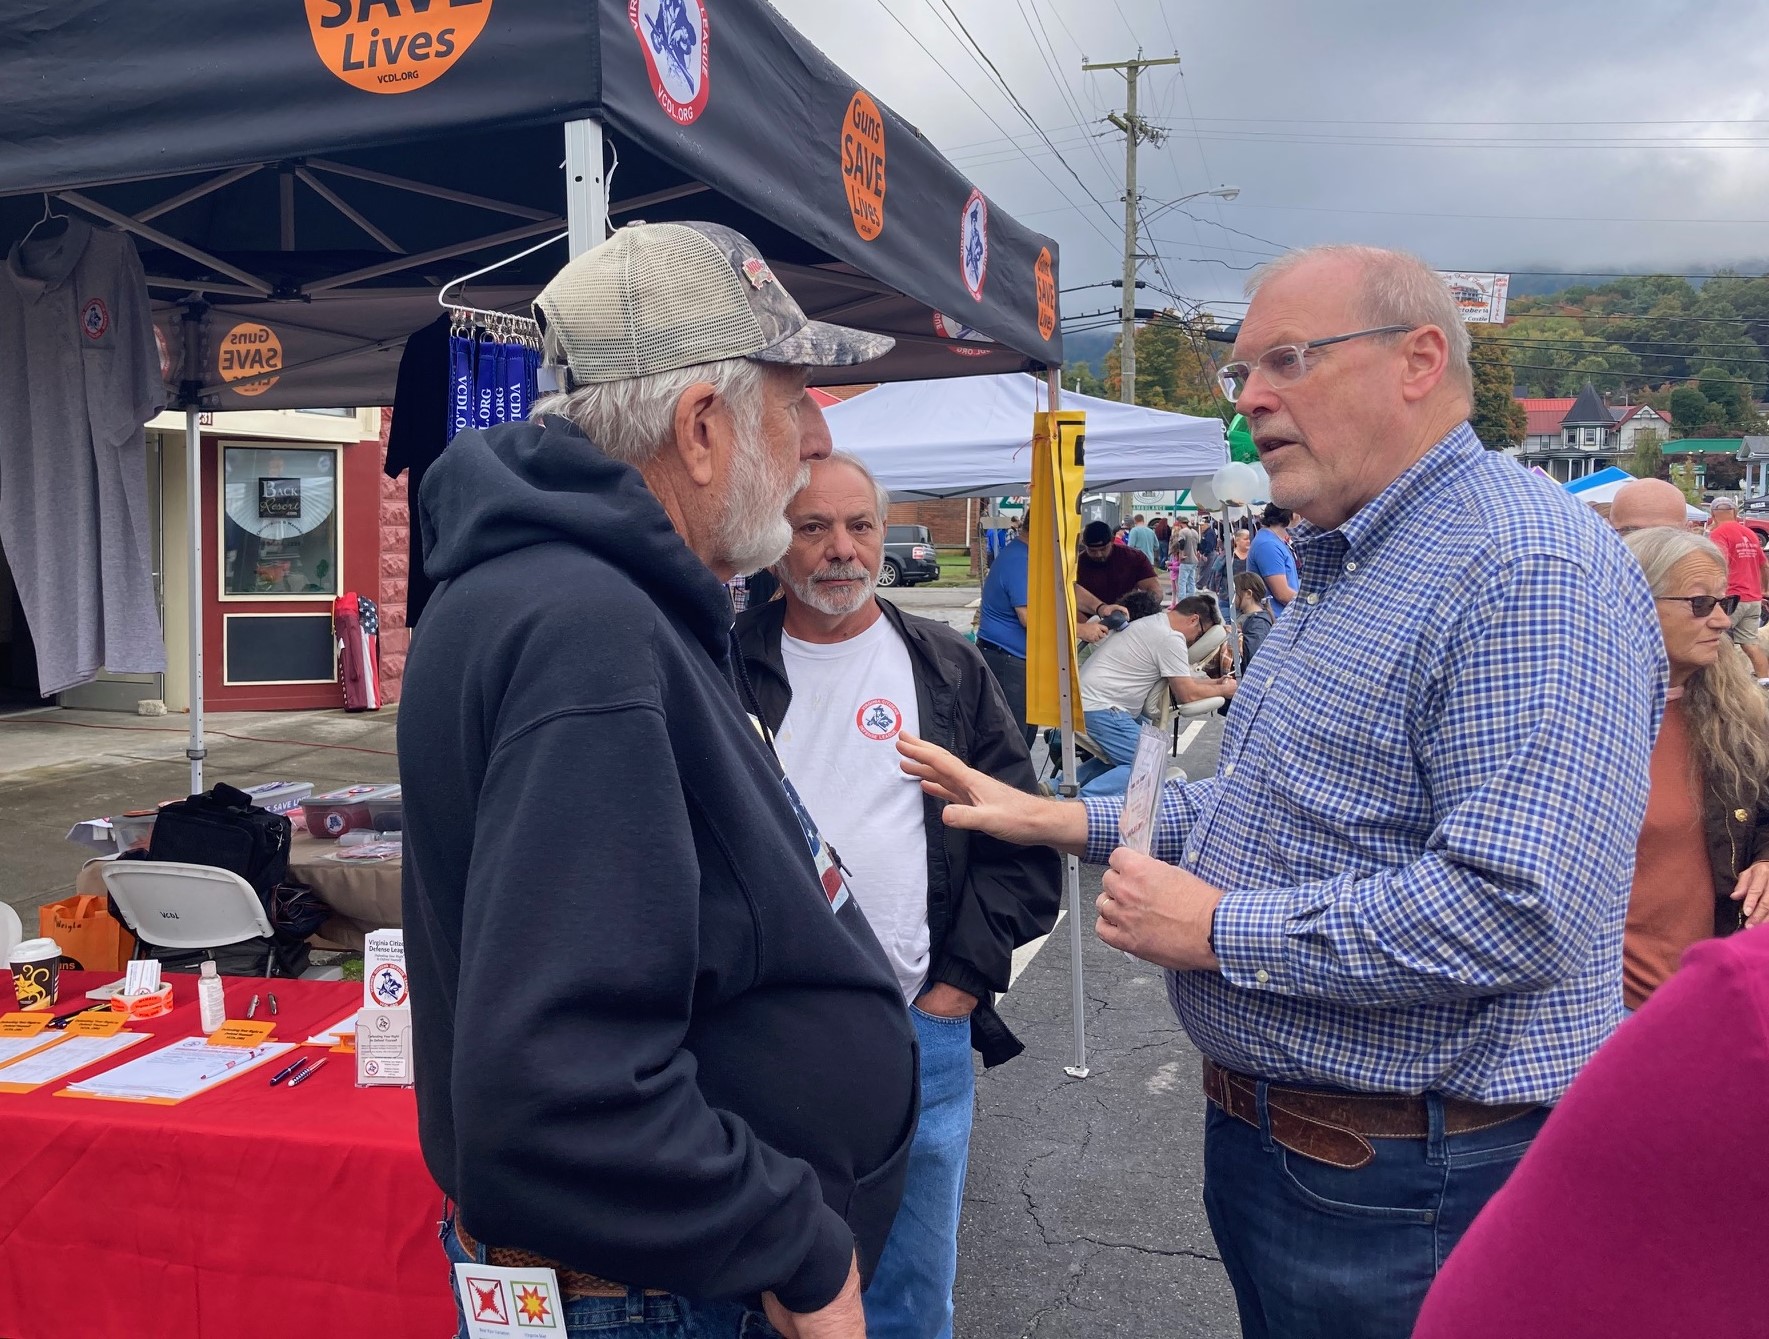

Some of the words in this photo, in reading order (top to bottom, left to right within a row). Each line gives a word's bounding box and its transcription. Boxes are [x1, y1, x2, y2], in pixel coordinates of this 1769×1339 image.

[342, 28, 456, 71] Lives
[700, 8, 708, 78] LEAGUE
[377, 70, 419, 84] VCDL.ORG
[658, 84, 694, 121] VCDL.ORG
[852, 98, 881, 144] Guns
[844, 134, 883, 198] SAVE
[852, 185, 880, 227] Lives
[1037, 275, 1054, 310] SAVE
[1039, 308, 1052, 331] Lives
[260, 498, 300, 514] Resort
[262, 481, 298, 498] BACK
[273, 800, 292, 812] SAVE
